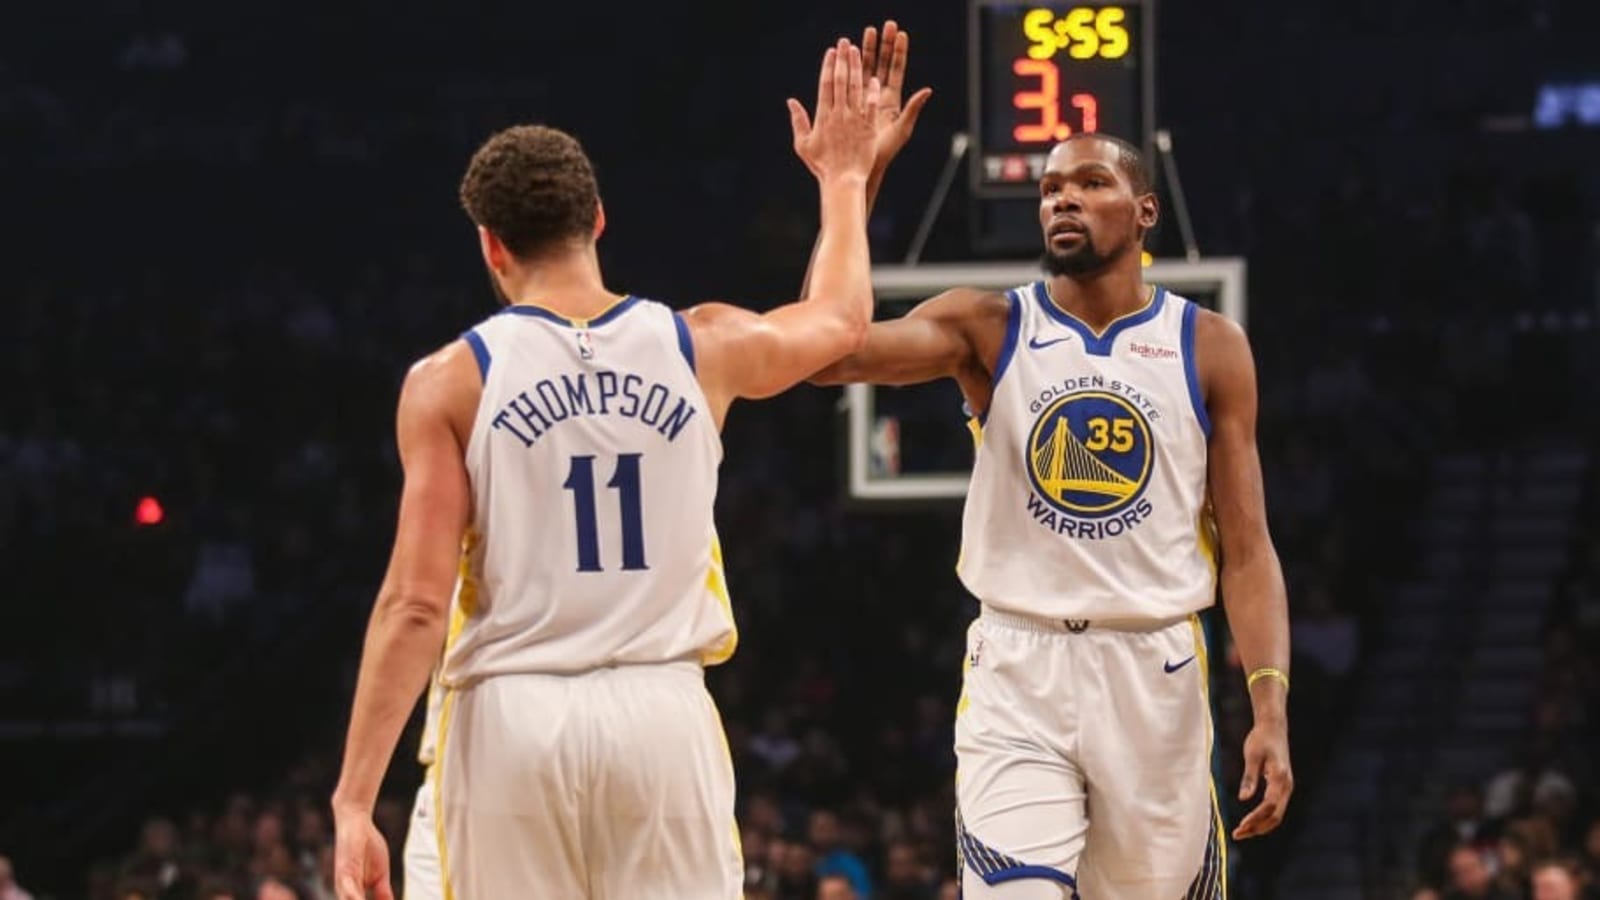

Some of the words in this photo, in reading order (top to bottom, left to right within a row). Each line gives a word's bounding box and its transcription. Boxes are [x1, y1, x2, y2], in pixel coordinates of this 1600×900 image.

[1023, 7, 1129, 60] 5:55
[1130, 342, 1178, 359] Rakuten
[492, 371, 696, 448] THOMPSON
[1029, 375, 1104, 414] GOLDEN
[1110, 380, 1161, 422] STATE
[1085, 416, 1135, 453] 35
[562, 453, 650, 572] 11
[1026, 493, 1153, 540] WARRIORS
